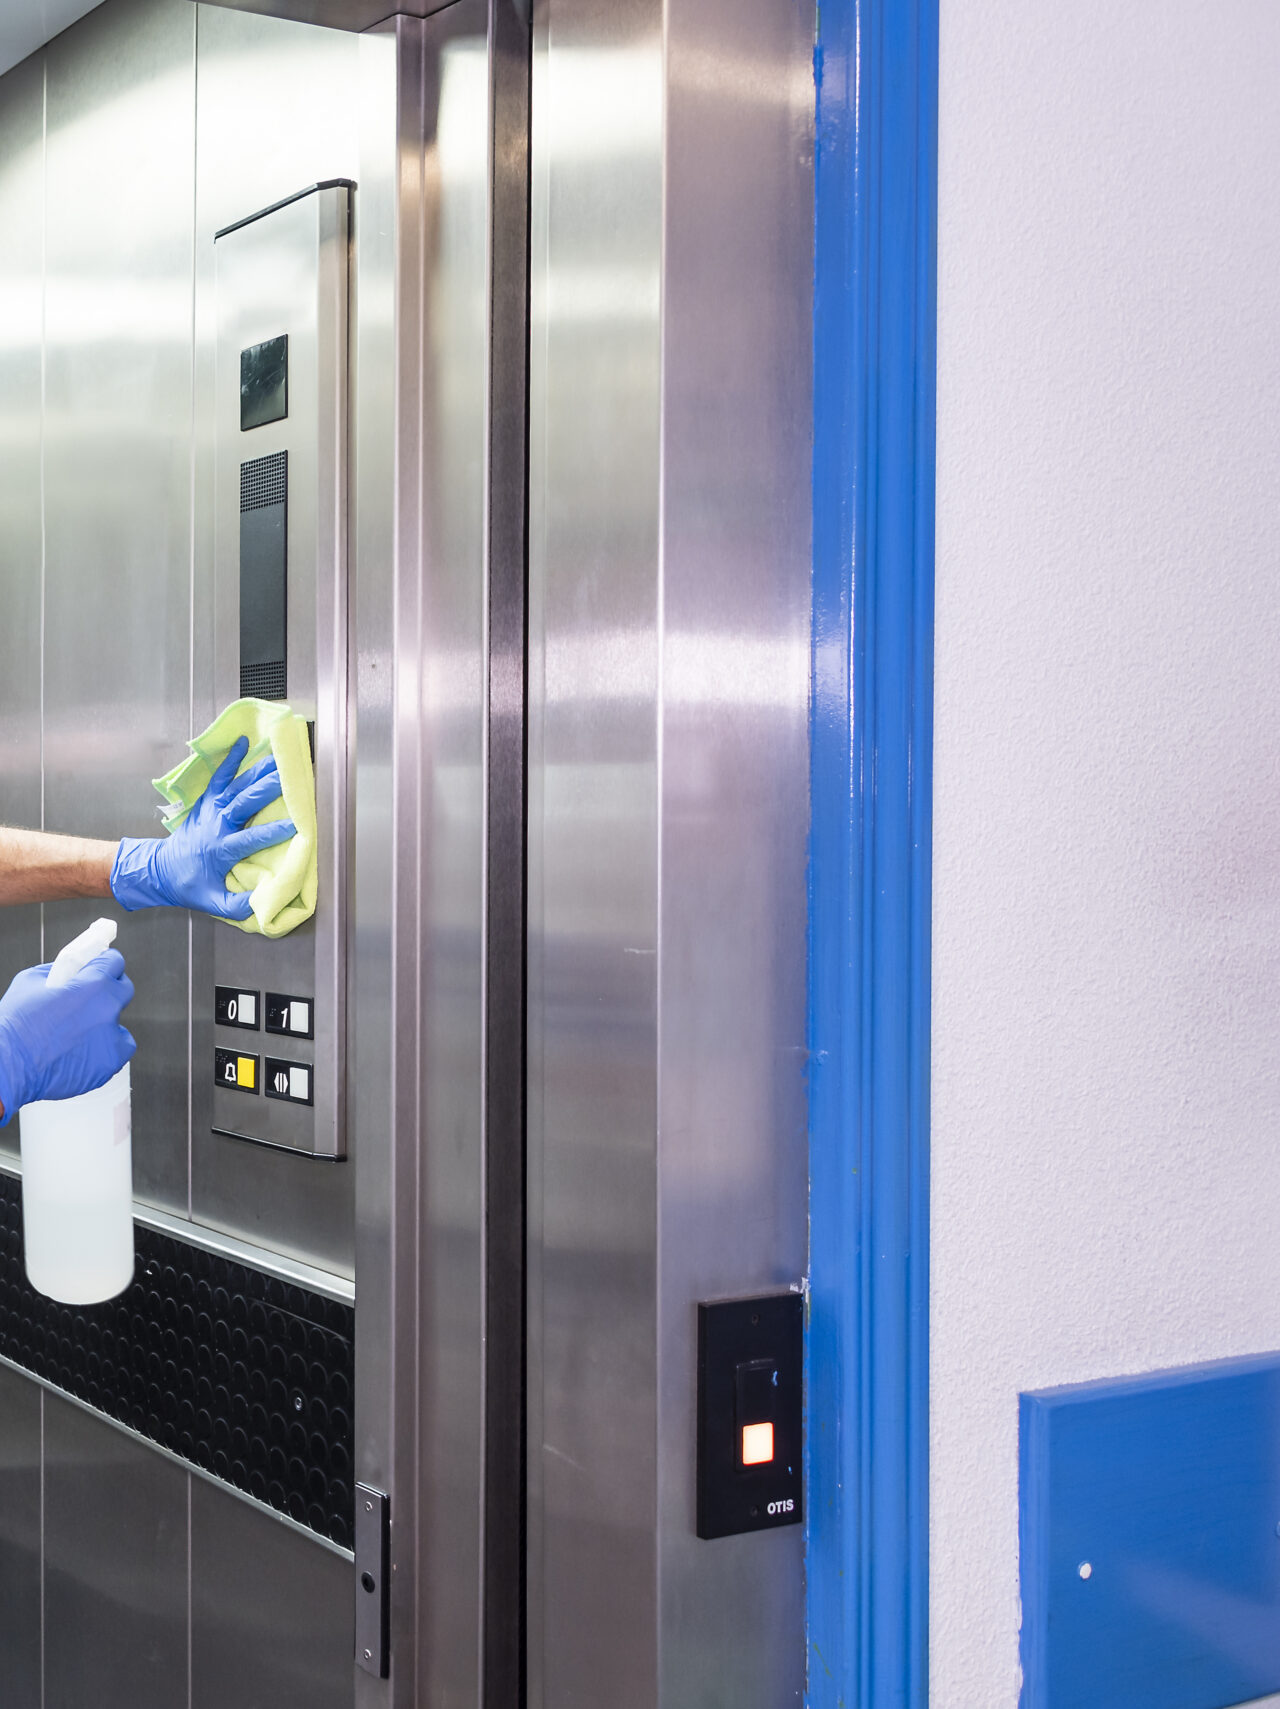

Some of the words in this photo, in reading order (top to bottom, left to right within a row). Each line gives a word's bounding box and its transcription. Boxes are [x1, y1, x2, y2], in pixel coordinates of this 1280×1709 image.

[228, 1000, 237, 1020] 0
[281, 1008, 288, 1028] 1
[767, 1498, 794, 1515] OTIS
